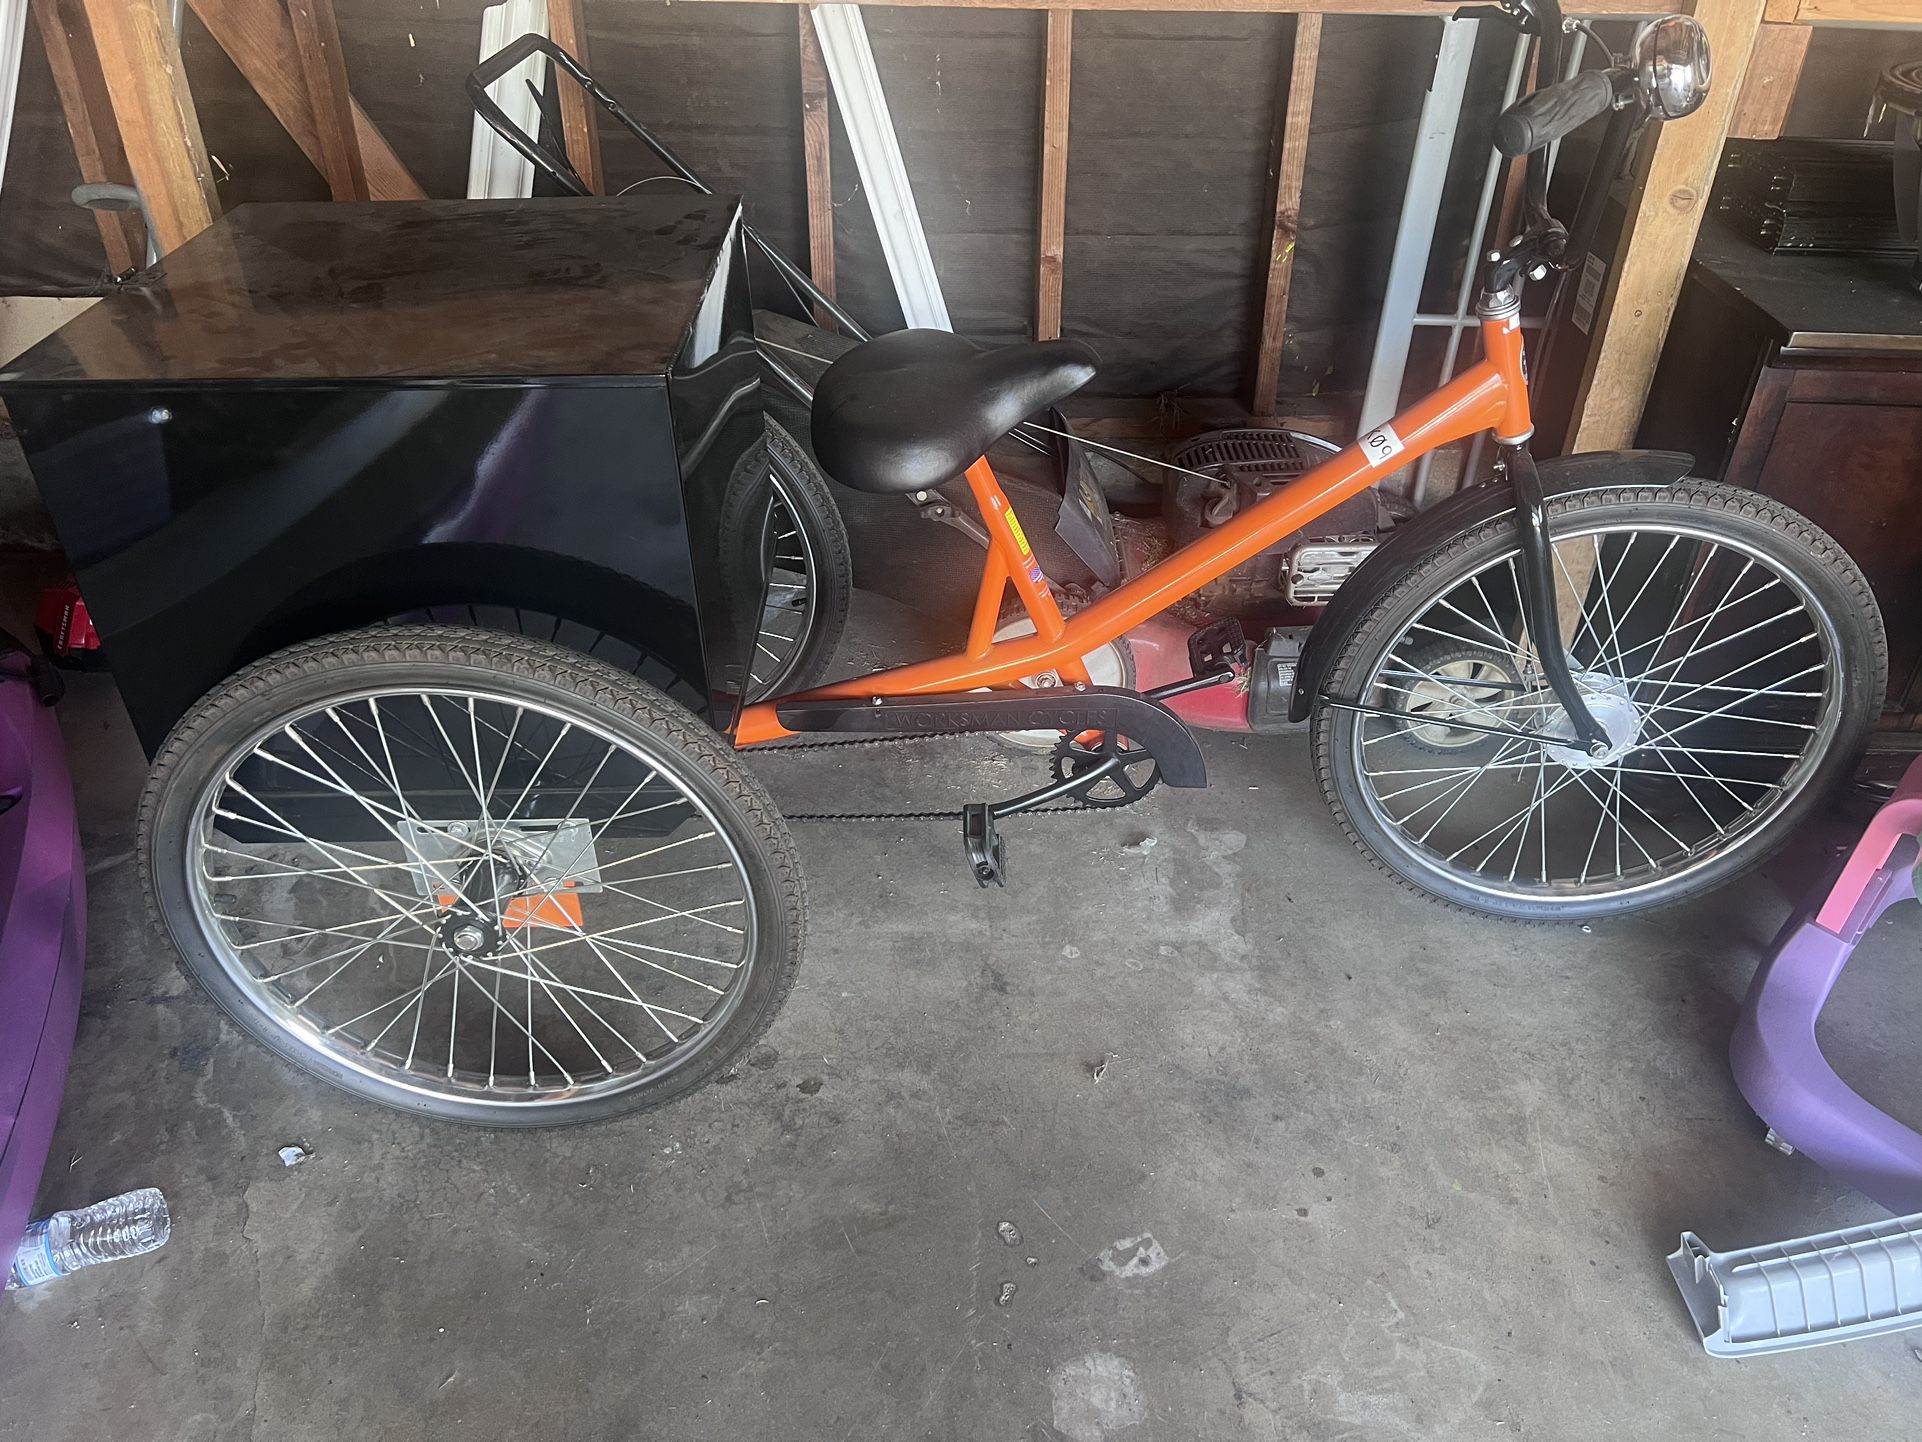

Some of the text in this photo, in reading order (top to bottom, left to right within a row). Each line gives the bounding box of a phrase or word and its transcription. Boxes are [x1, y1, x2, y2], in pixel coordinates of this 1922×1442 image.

[57, 604, 70, 650] CRAFTSMAN
[895, 709, 1107, 728] WORKSMAN CYCLES
